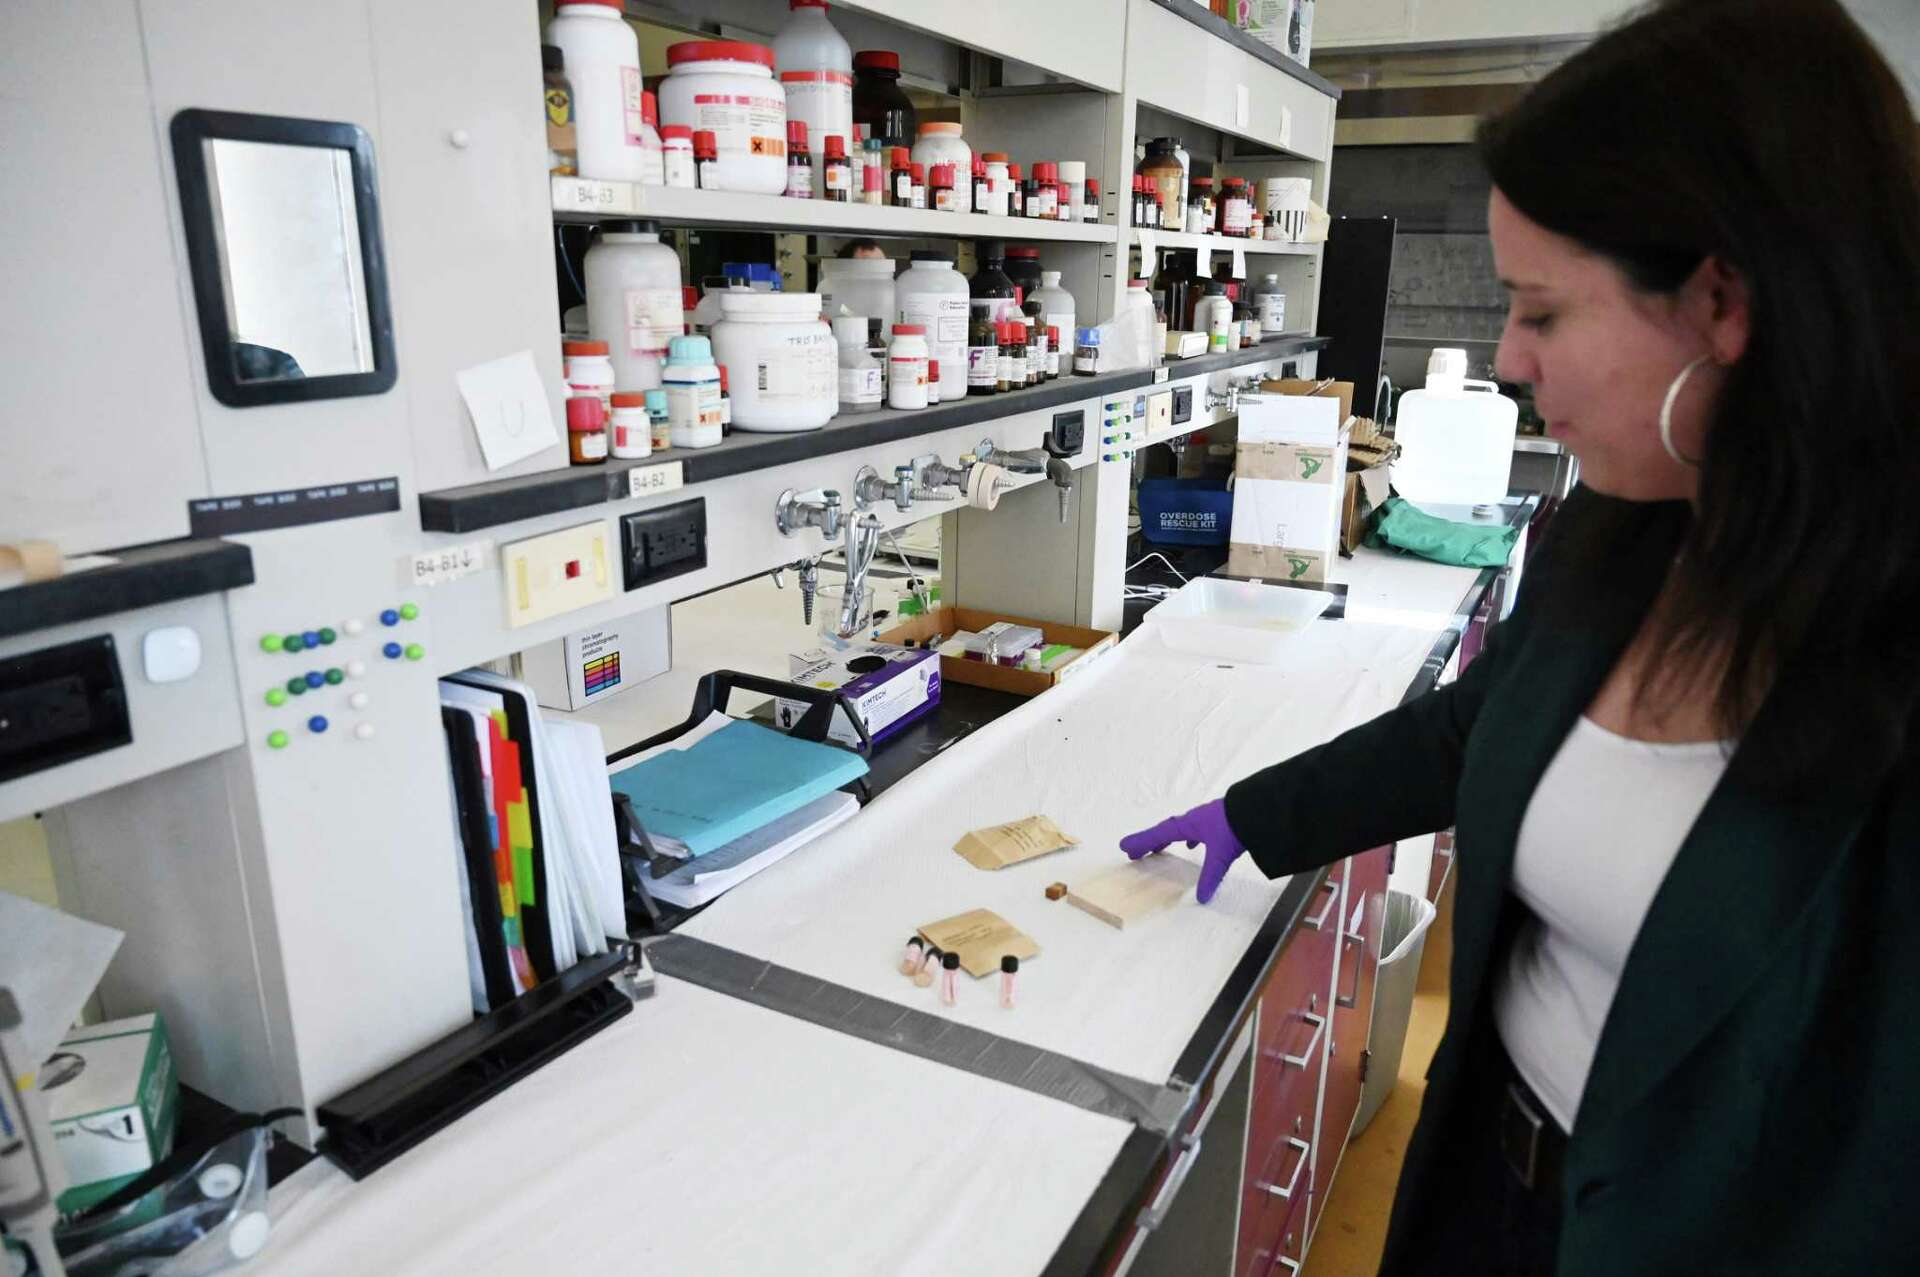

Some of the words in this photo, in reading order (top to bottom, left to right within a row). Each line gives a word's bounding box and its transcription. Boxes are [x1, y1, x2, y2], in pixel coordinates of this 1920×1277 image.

[632, 471, 665, 492] B4-B2
[1160, 512, 1217, 521] OVERDOSE
[1160, 519, 1199, 528] RESCUE
[1201, 520, 1217, 528] KIT
[581, 634, 591, 643] thin
[592, 631, 603, 641] layer
[790, 660, 837, 684] KIMTECH
[862, 690, 887, 709] KIMTECH
[122, 1114, 133, 1135] 1
